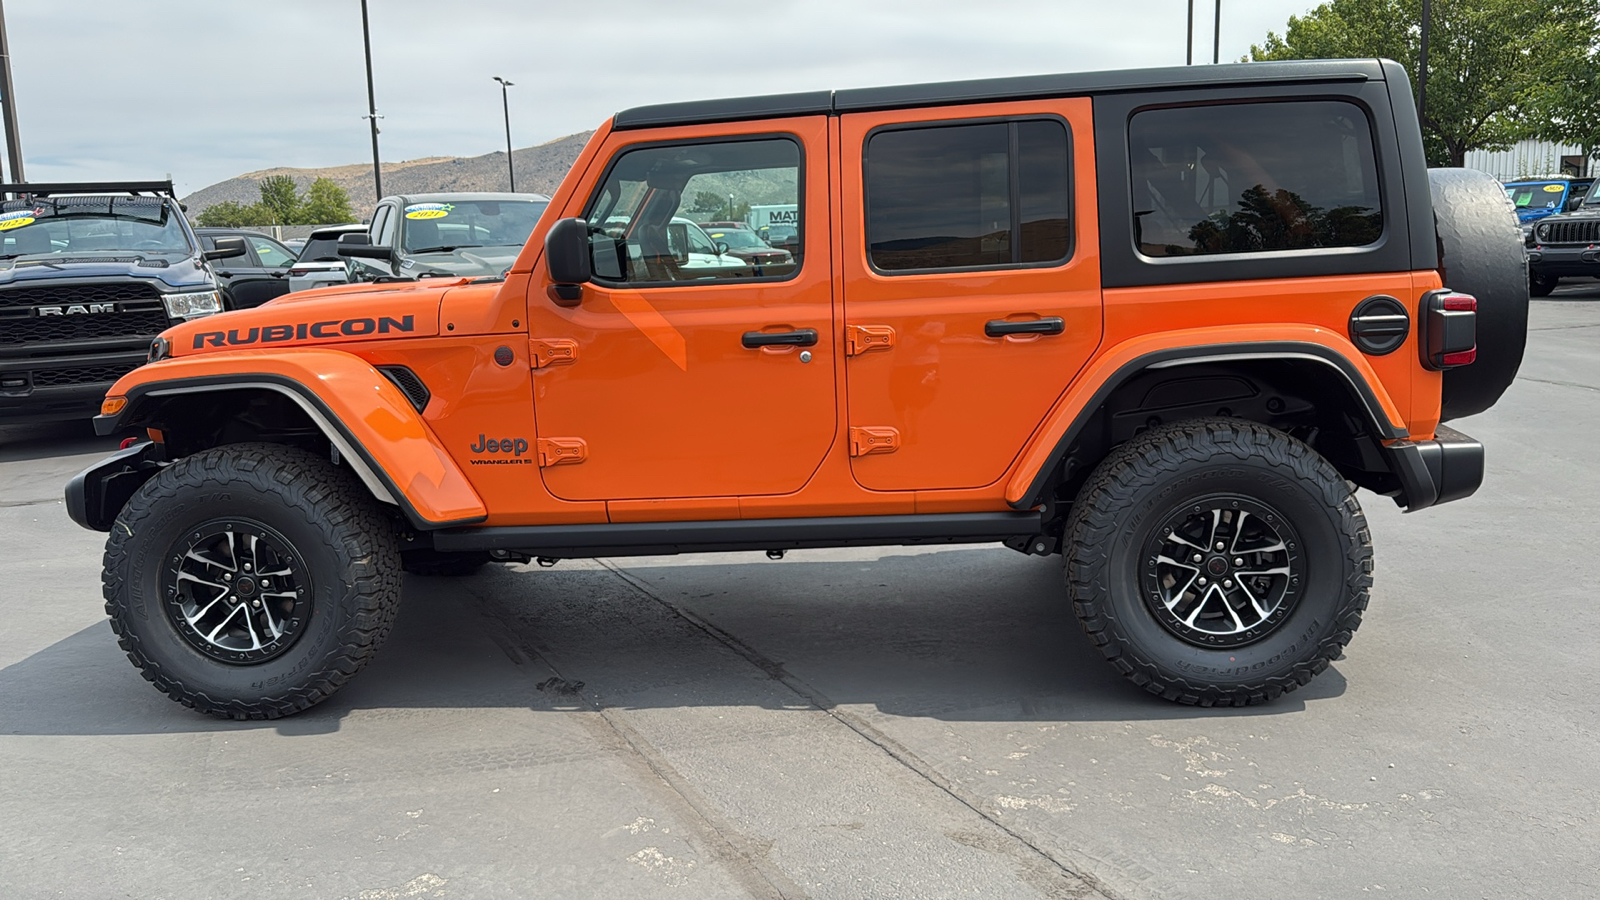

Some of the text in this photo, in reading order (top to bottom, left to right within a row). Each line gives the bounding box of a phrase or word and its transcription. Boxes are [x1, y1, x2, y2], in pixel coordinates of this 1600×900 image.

[413, 210, 440, 218] 2021
[38, 303, 115, 317] RAM
[192, 315, 415, 349] RUBICON
[470, 434, 529, 456] Jeep
[195, 492, 233, 504] T/A
